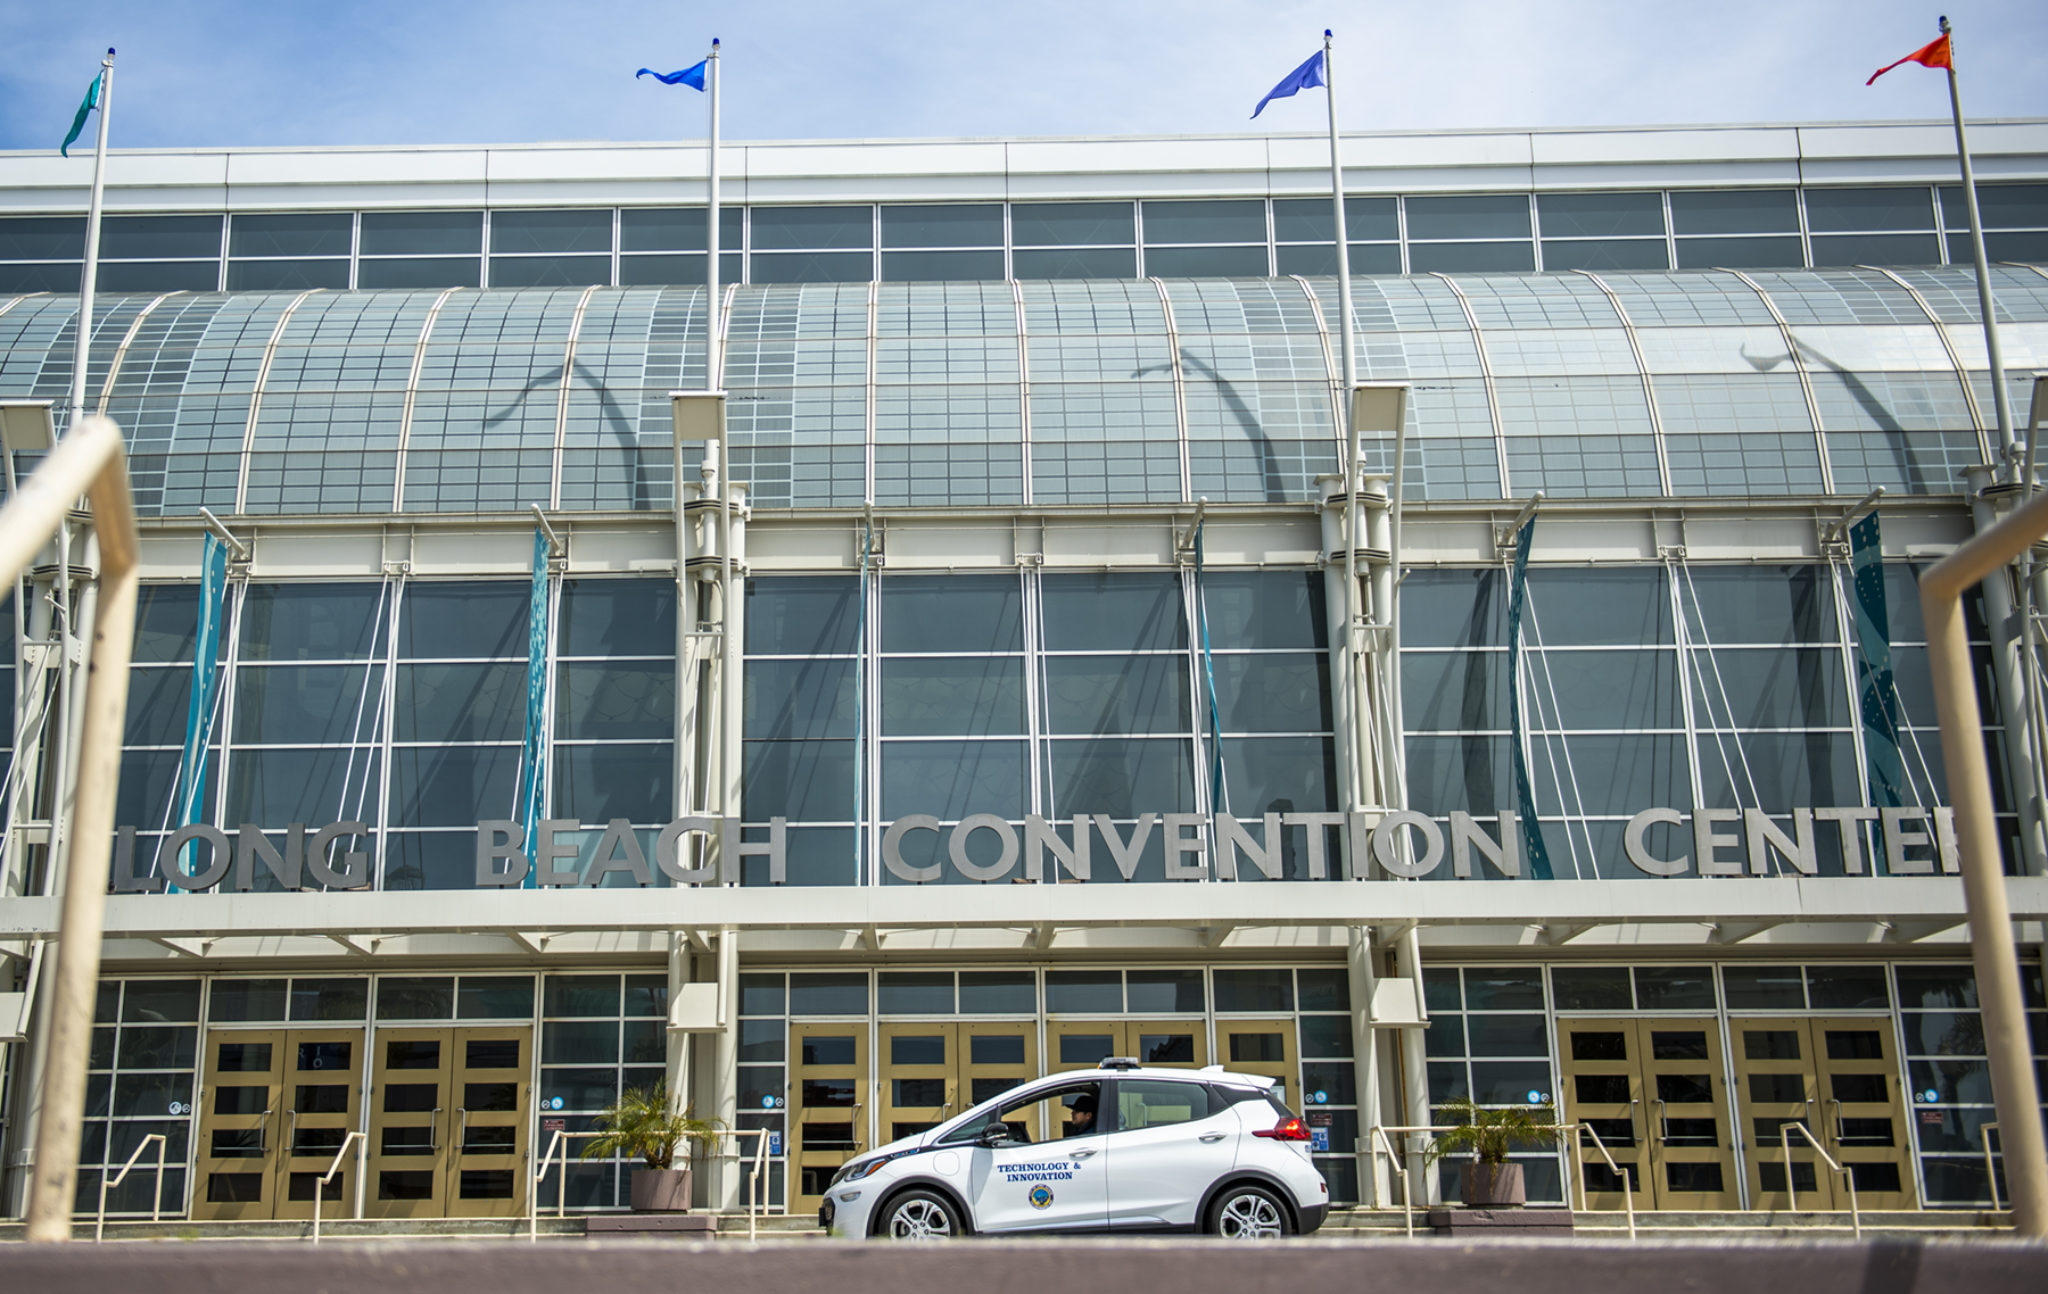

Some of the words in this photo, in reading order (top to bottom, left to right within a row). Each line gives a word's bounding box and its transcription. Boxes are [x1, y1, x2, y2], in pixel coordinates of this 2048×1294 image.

[113, 820, 369, 892] LONG
[475, 815, 787, 887] BEACH
[882, 809, 1522, 883] CONVENTION
[997, 1162, 1069, 1173] TECHNOLOGY
[1073, 1162, 1081, 1170] &
[1007, 1171, 1073, 1182] INNOVATION
